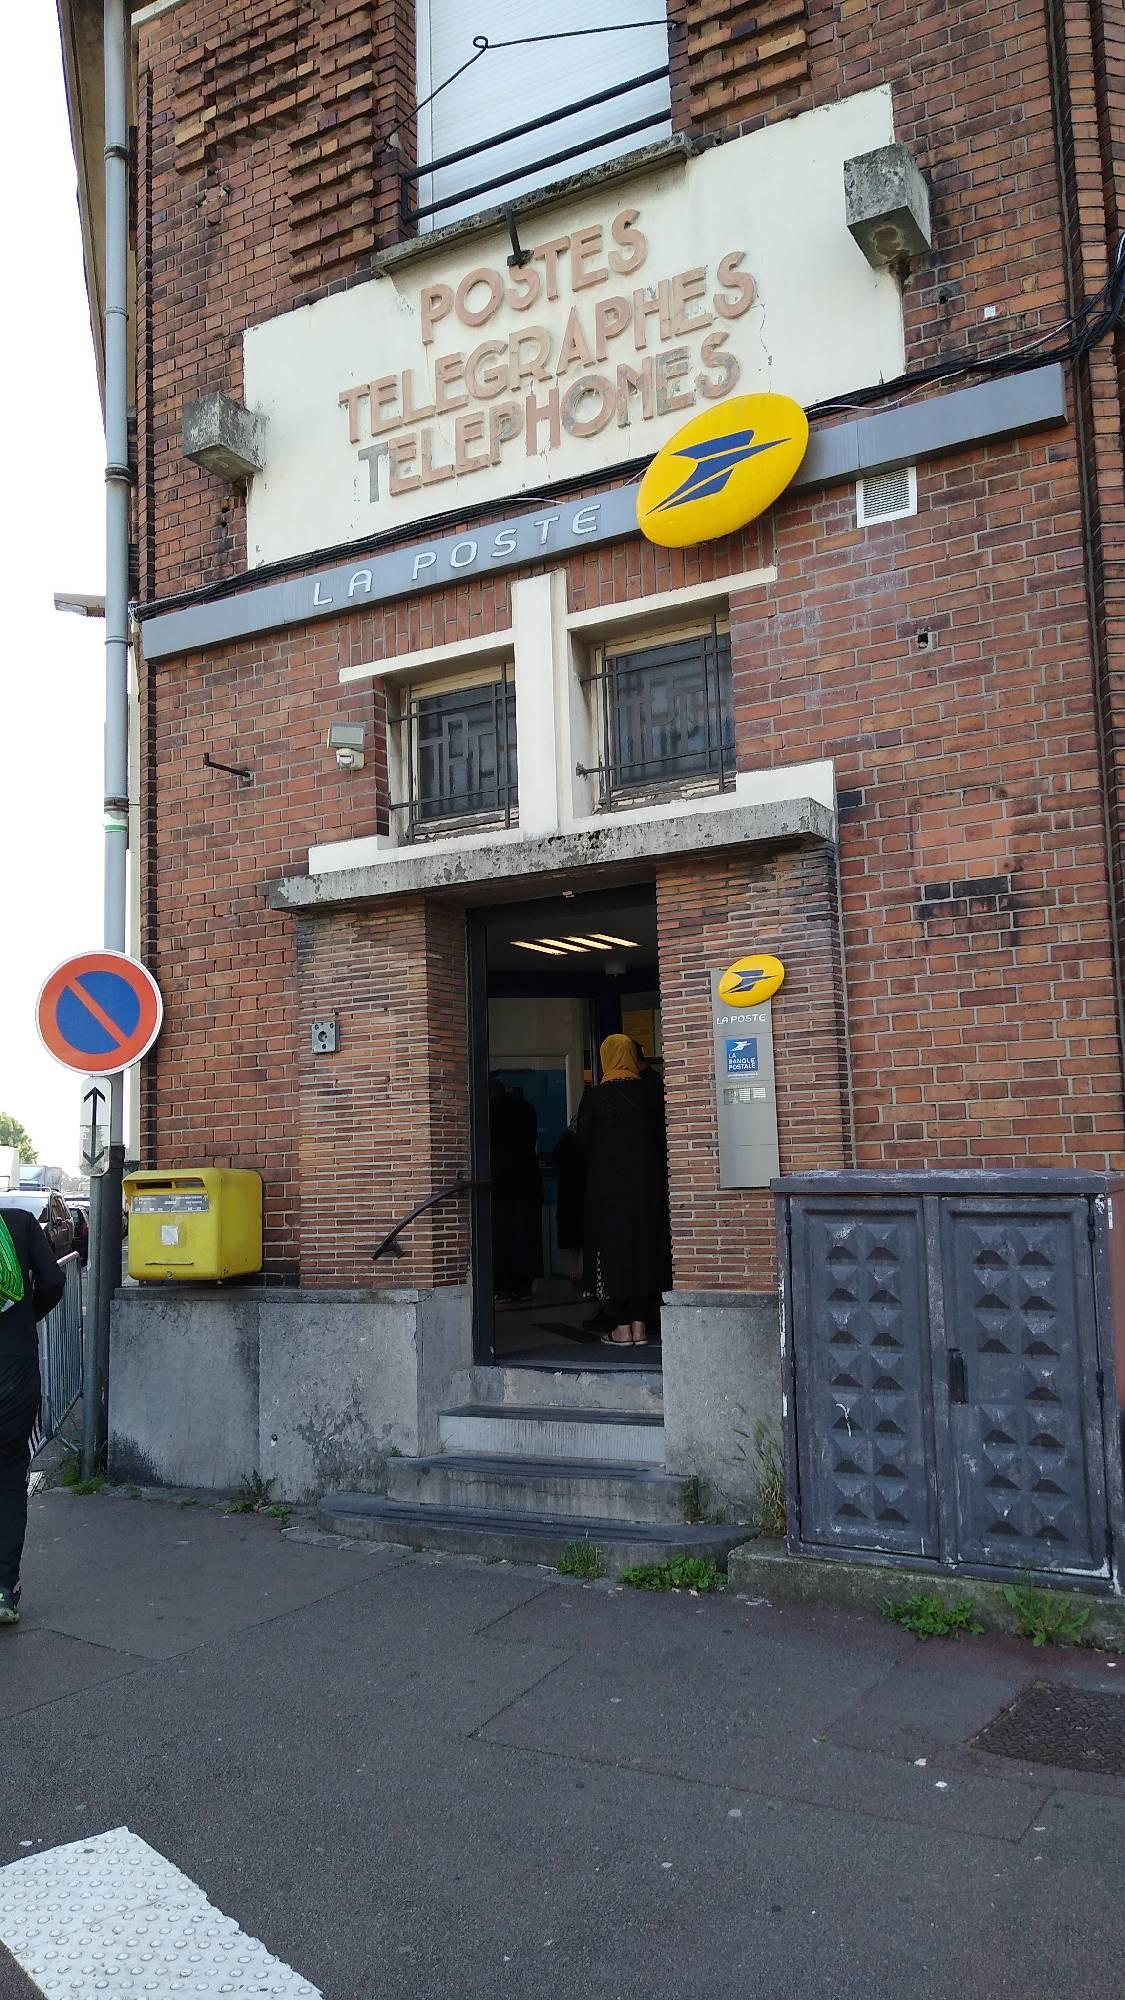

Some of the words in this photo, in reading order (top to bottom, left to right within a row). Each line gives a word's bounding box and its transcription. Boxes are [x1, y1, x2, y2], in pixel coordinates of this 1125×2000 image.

[421, 209, 648, 346] POSTES
[339, 251, 757, 443] TELEGRAPHES
[357, 331, 741, 503] TELEPHONES
[312, 569, 372, 606] LA
[411, 504, 601, 581] POSTE
[716, 1016, 729, 1025] LA
[730, 1013, 766, 1024] POSTE
